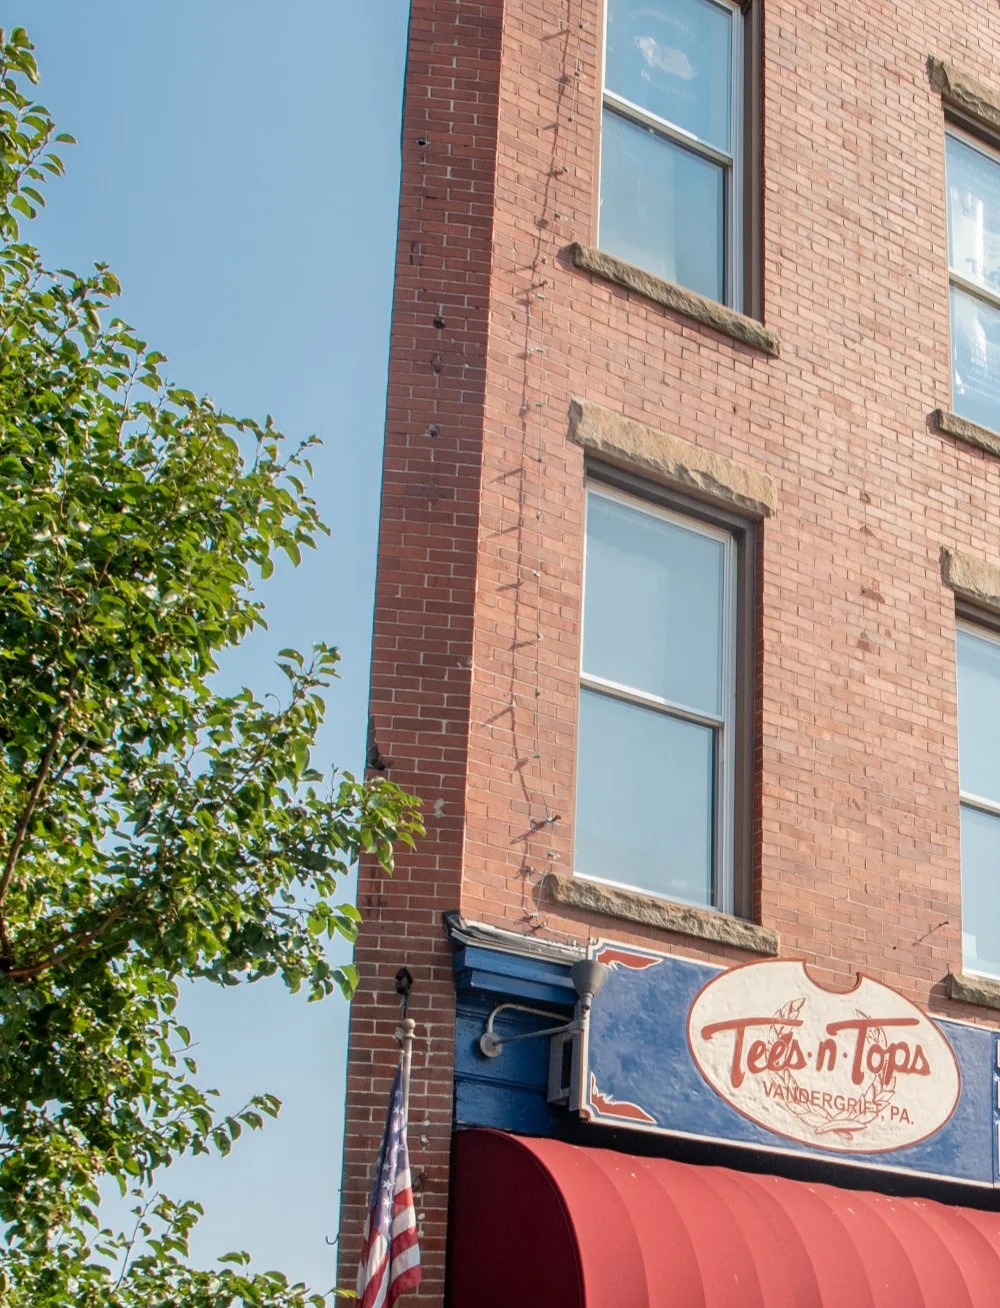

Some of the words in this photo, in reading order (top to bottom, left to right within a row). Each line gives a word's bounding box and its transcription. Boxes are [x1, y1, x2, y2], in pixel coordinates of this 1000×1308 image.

[701, 1017, 808, 1088] Tees
[826, 1017, 931, 1086] Tops
[762, 1081, 885, 1120] VANDERGRIFT,
[890, 1106, 915, 1125] PA.
